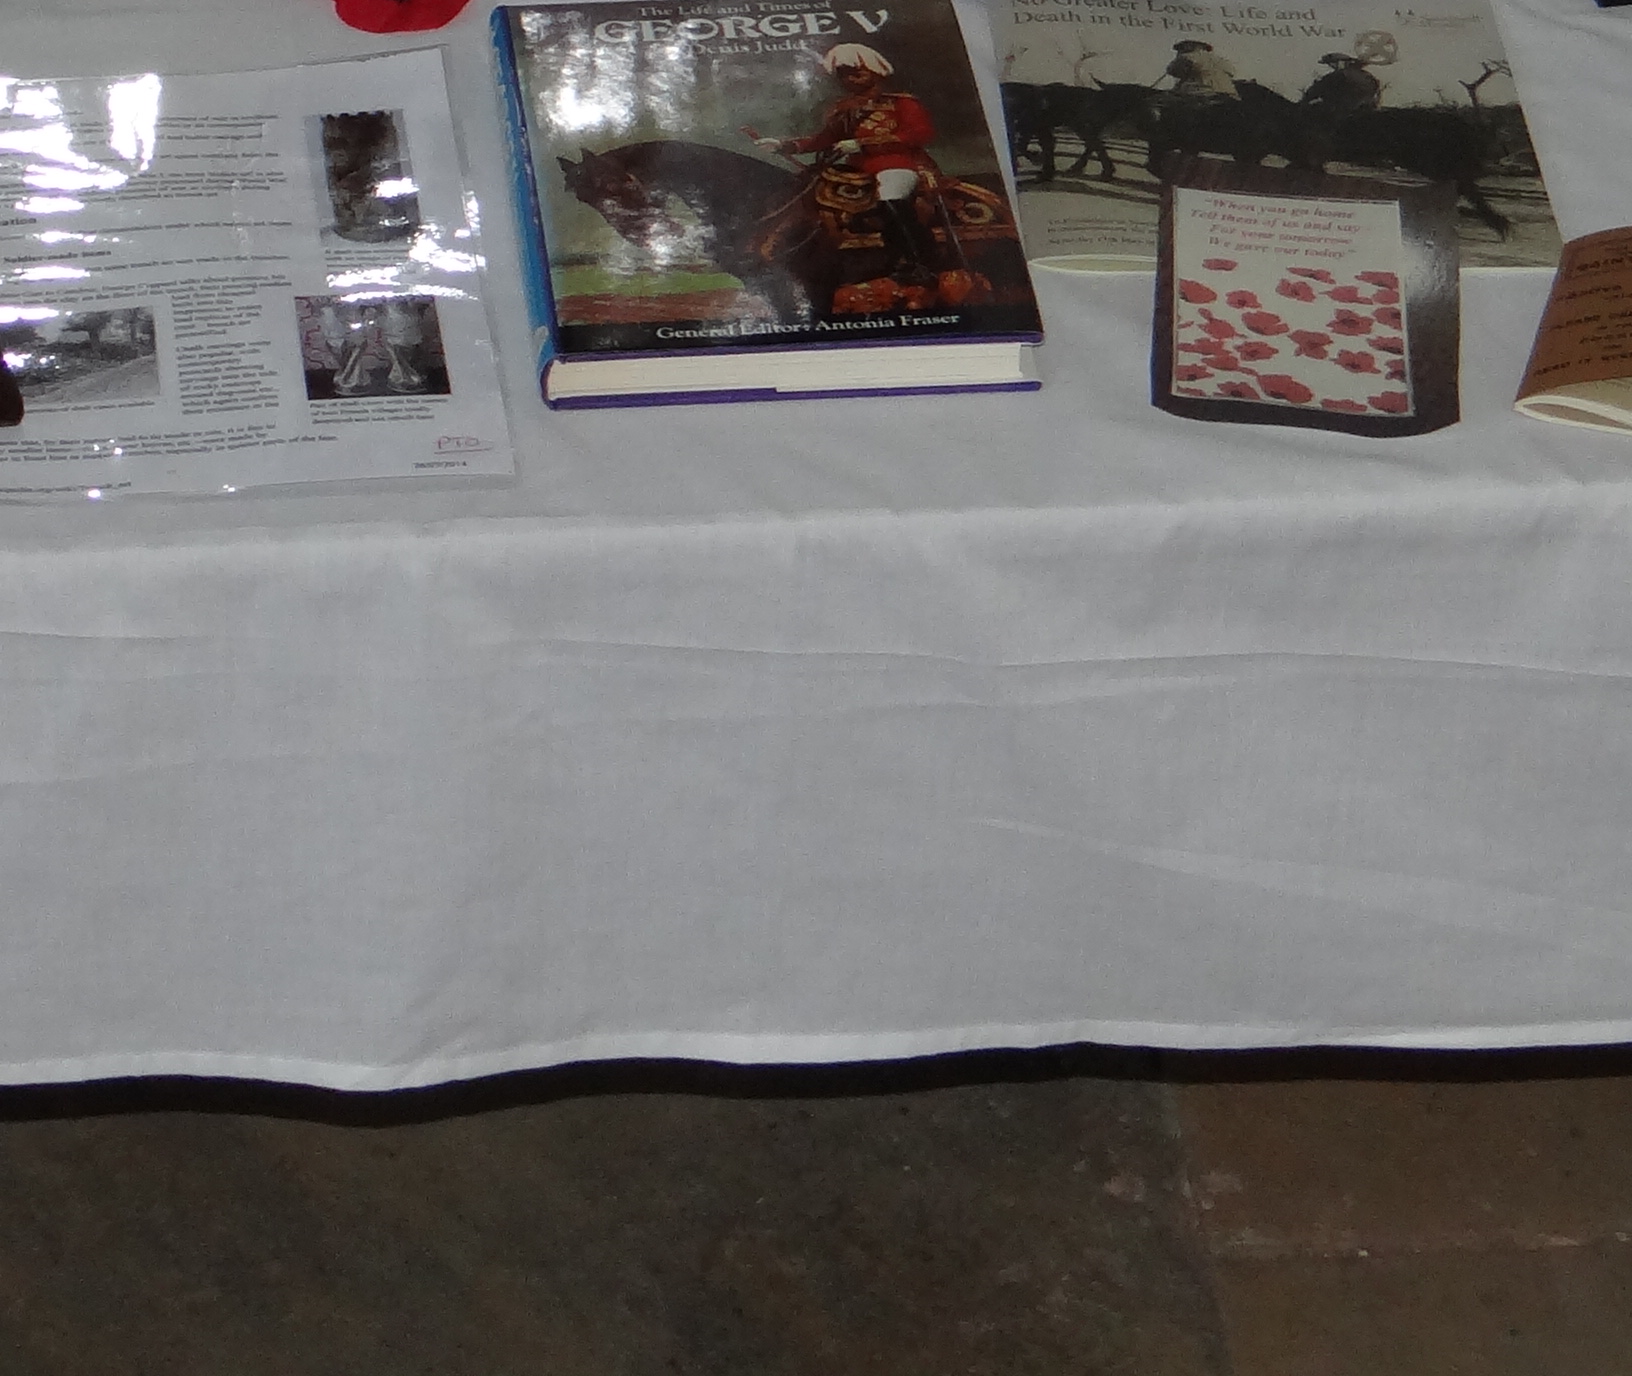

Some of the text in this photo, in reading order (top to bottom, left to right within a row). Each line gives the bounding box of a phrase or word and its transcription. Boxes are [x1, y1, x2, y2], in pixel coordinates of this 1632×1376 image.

[637, 6, 670, 17] The
[755, 1, 810, 14] Times
[813, 0, 832, 12] of
[1220, 6, 1268, 21] Life
[1274, 8, 1317, 21] and
[594, 9, 890, 44] GEORGE V
[1013, 11, 1347, 39] Death in the First World War
[655, 325, 734, 340] General
[815, 317, 896, 332] Antonia
[899, 314, 961, 327] Fraser
